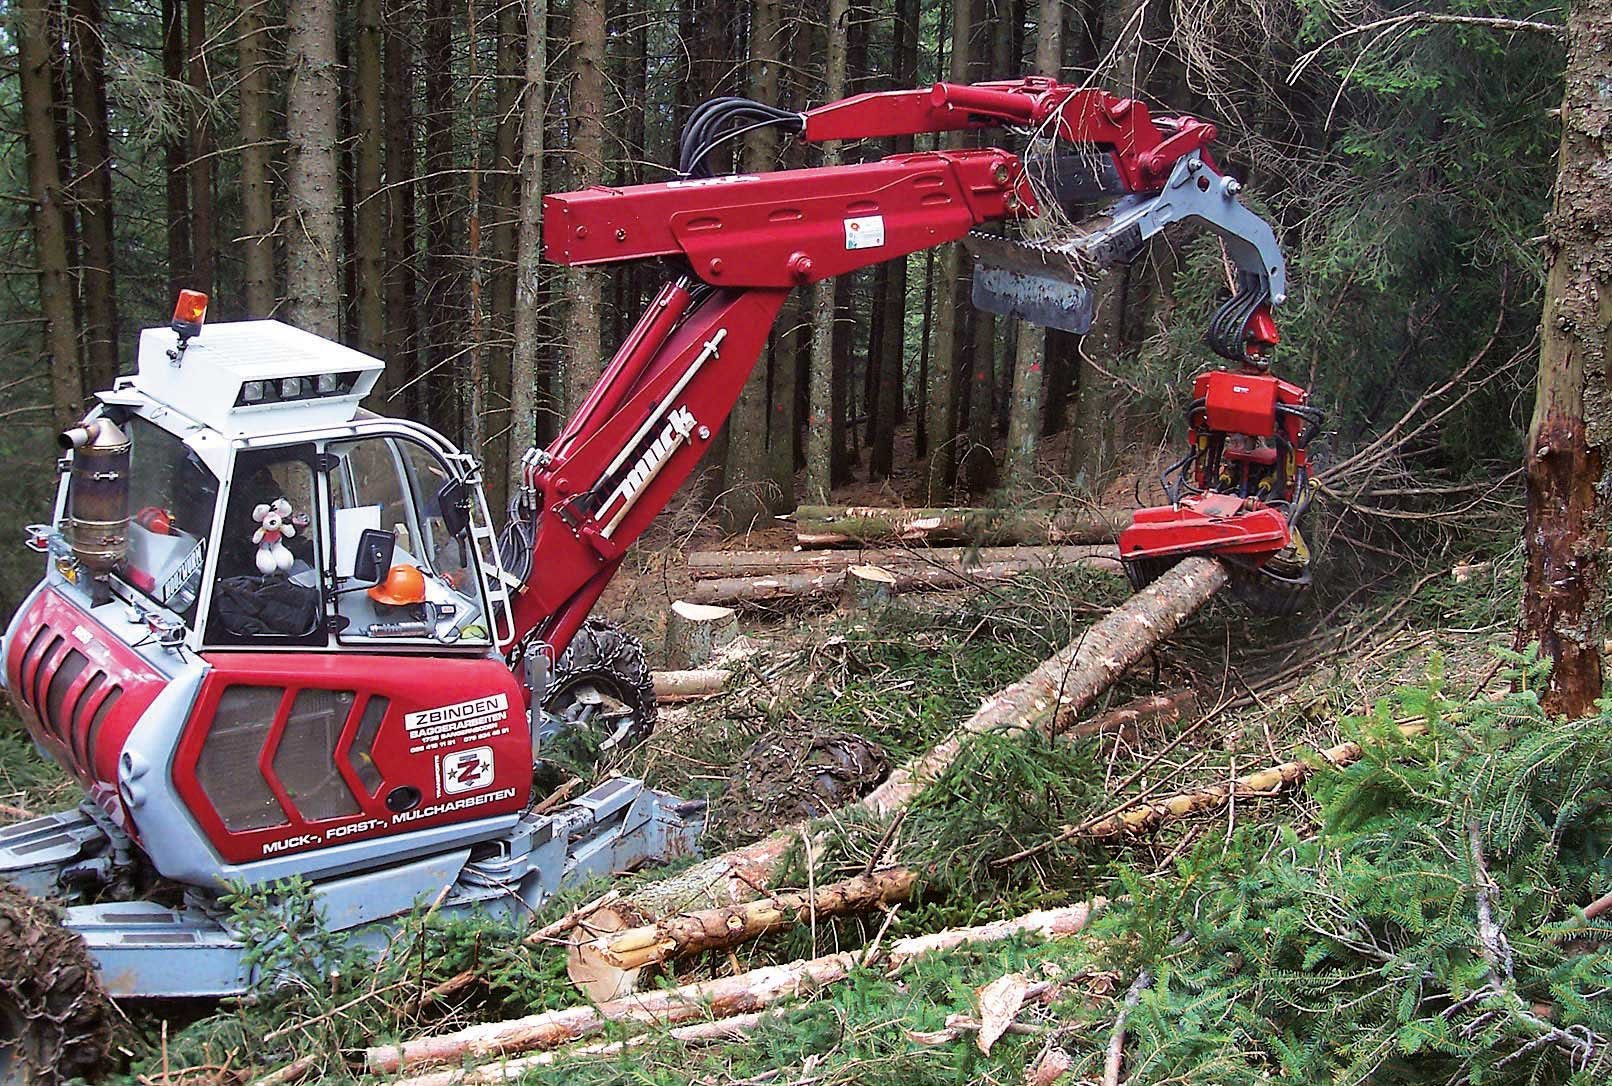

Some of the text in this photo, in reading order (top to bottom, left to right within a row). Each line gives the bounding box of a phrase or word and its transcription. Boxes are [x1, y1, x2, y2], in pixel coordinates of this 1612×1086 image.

[409, 711, 507, 739] BAGGERARBEITEN
[416, 698, 498, 725] ZBINDEN
[457, 759, 481, 783] Z
[262, 787, 516, 854] MUCK-, FORST-, MULCHARBEITEN
